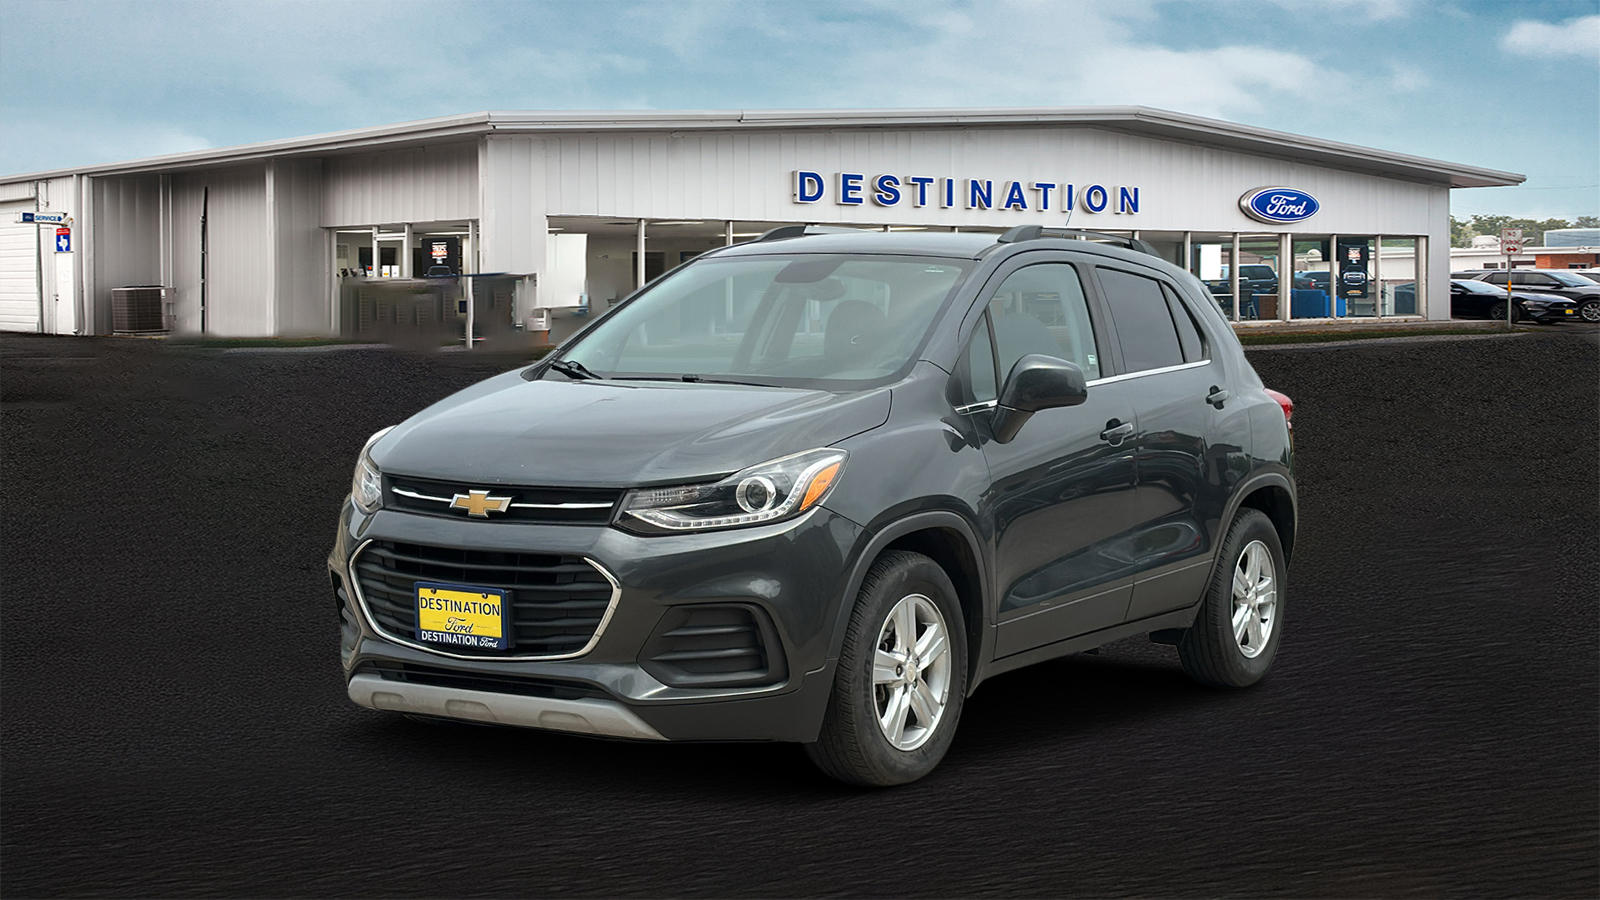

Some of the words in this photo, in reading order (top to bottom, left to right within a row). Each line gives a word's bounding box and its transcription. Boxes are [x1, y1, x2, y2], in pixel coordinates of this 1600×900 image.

[794, 170, 1140, 214] DESTINATION
[1266, 194, 1307, 216] Ford
[420, 597, 500, 616] DESTINATION
[445, 617, 474, 634] Ford
[421, 630, 478, 646] DESTINATION
[479, 636, 499, 648] Ford
